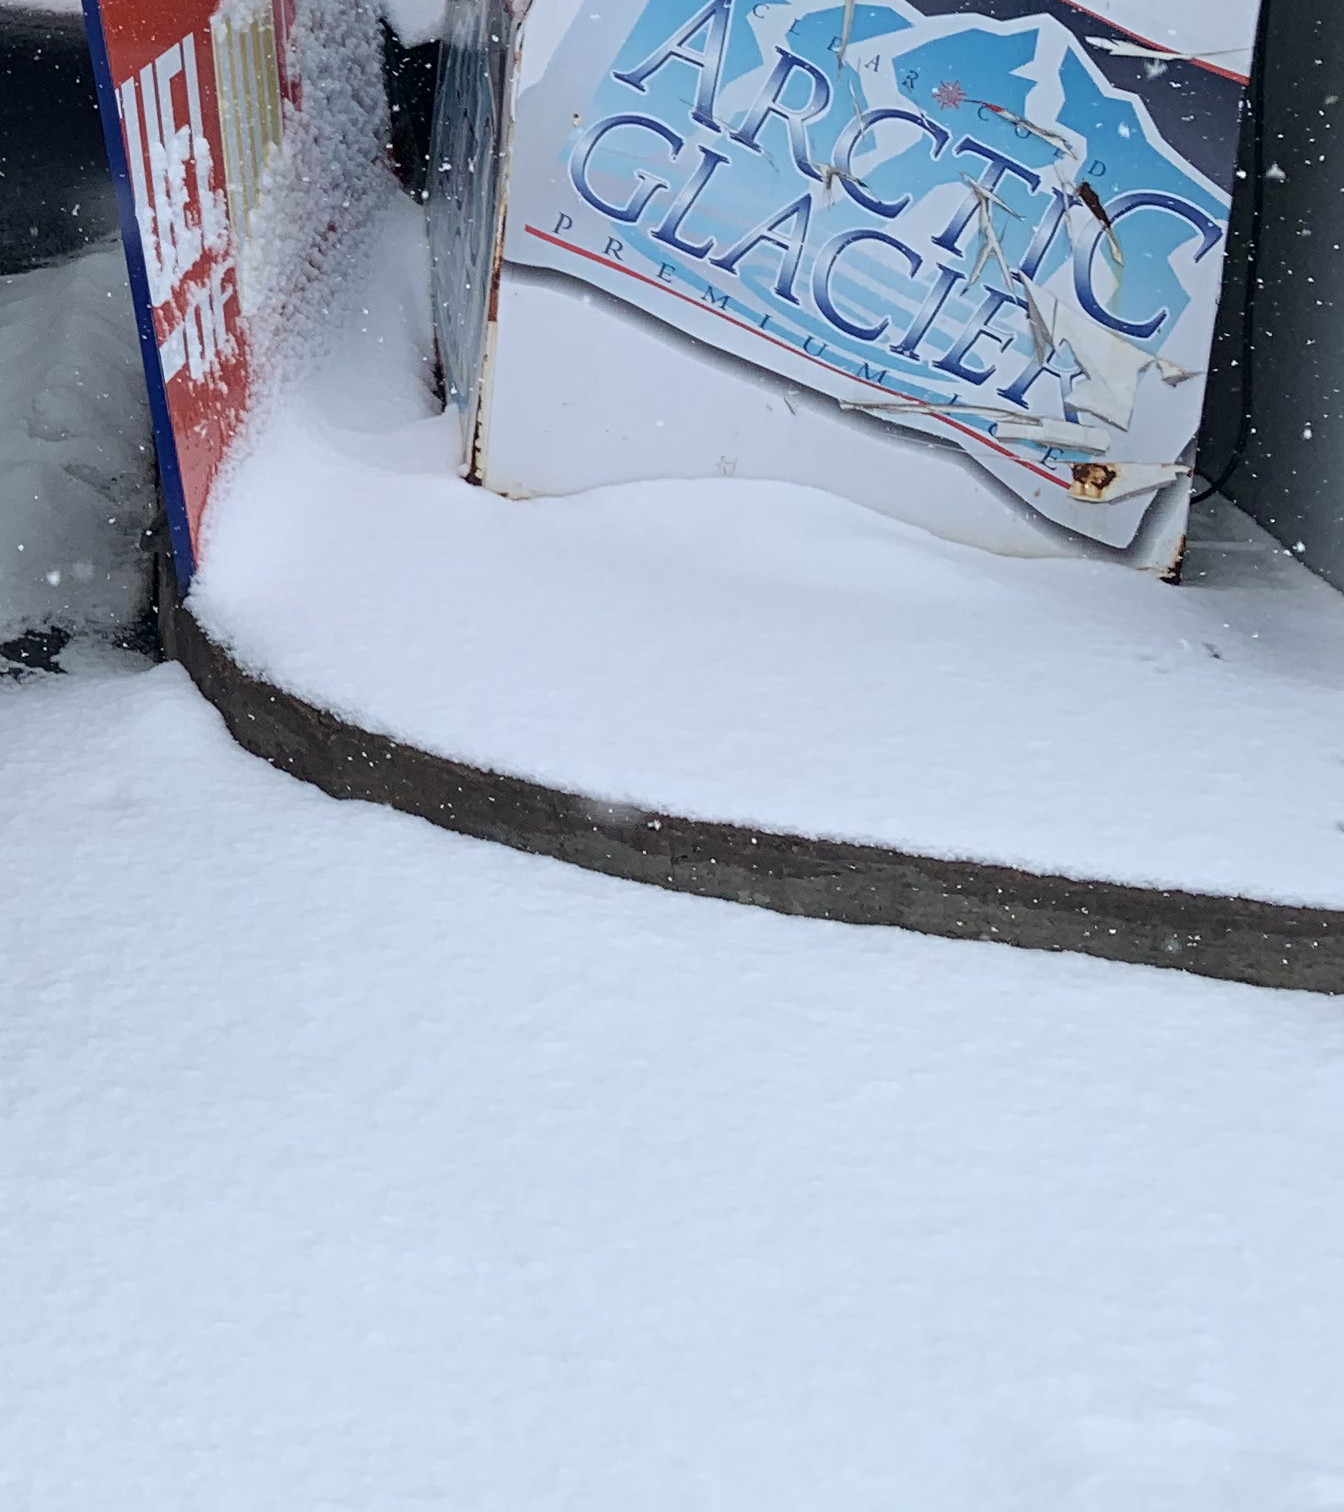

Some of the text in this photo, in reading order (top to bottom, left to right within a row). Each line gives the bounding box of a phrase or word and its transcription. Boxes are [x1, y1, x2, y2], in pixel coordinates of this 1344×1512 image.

[752, 3, 919, 89] CLEAR
[553, 212, 888, 384] PREMIUM
[569, 115, 1087, 425] GLACIER
